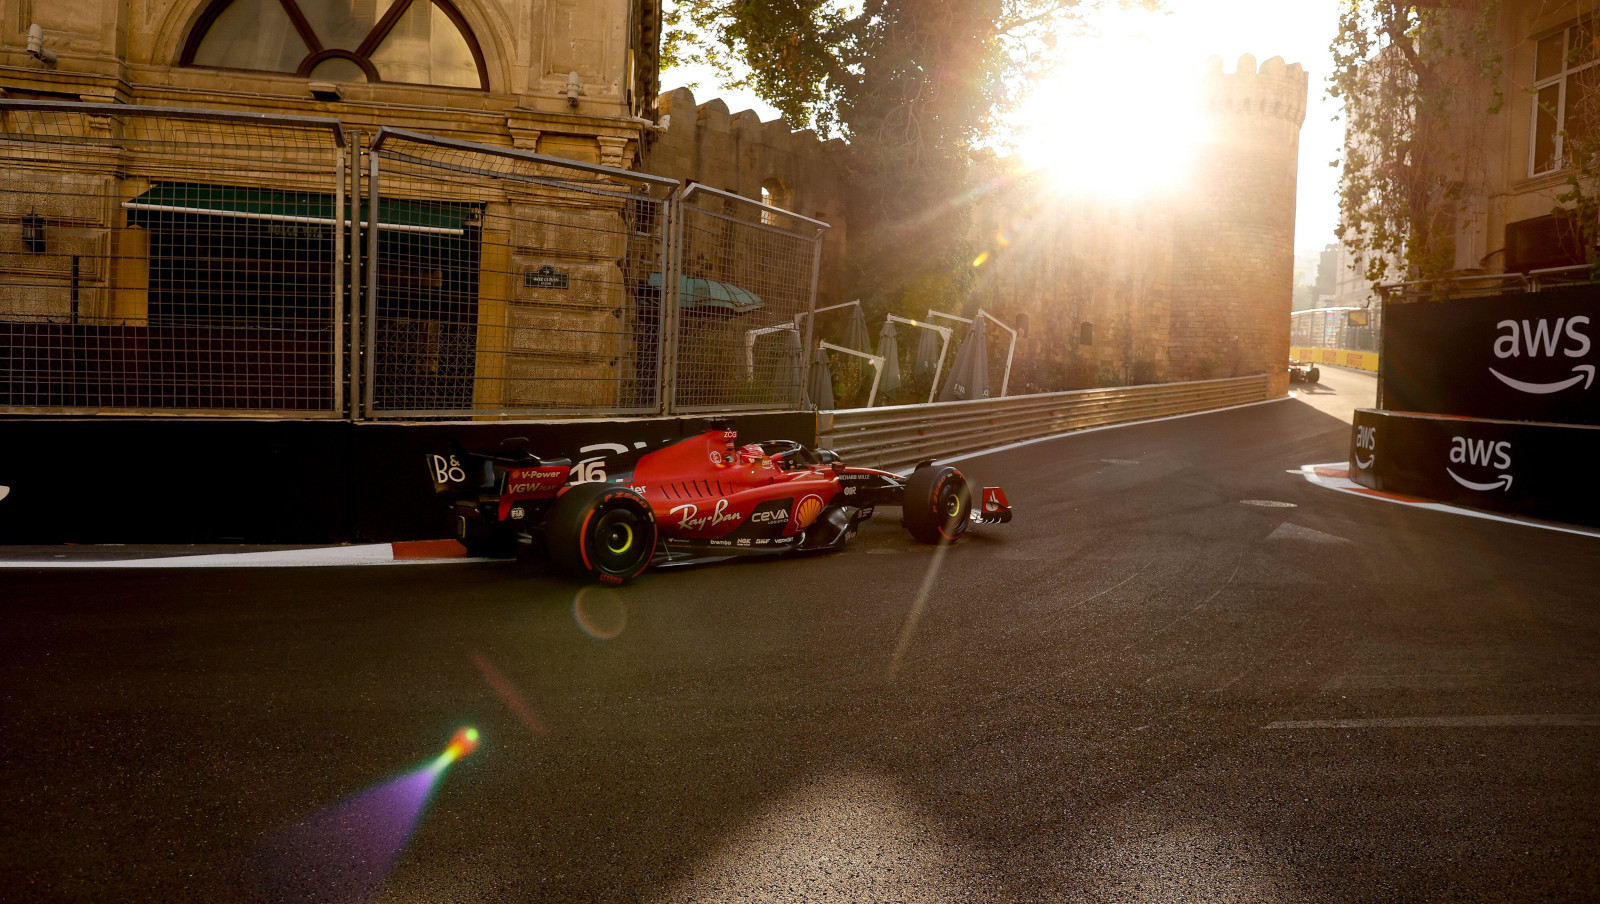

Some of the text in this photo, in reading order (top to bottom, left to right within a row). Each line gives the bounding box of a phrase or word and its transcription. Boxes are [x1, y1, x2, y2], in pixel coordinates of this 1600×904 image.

[1493, 315, 1591, 358] aws
[1356, 425, 1376, 450] aws
[1449, 436, 1512, 470] aws
[433, 454, 466, 484] B&O
[521, 470, 561, 479] V-Power
[569, 461, 607, 486] 16
[508, 483, 540, 495] VGW
[614, 492, 648, 508] ZERO
